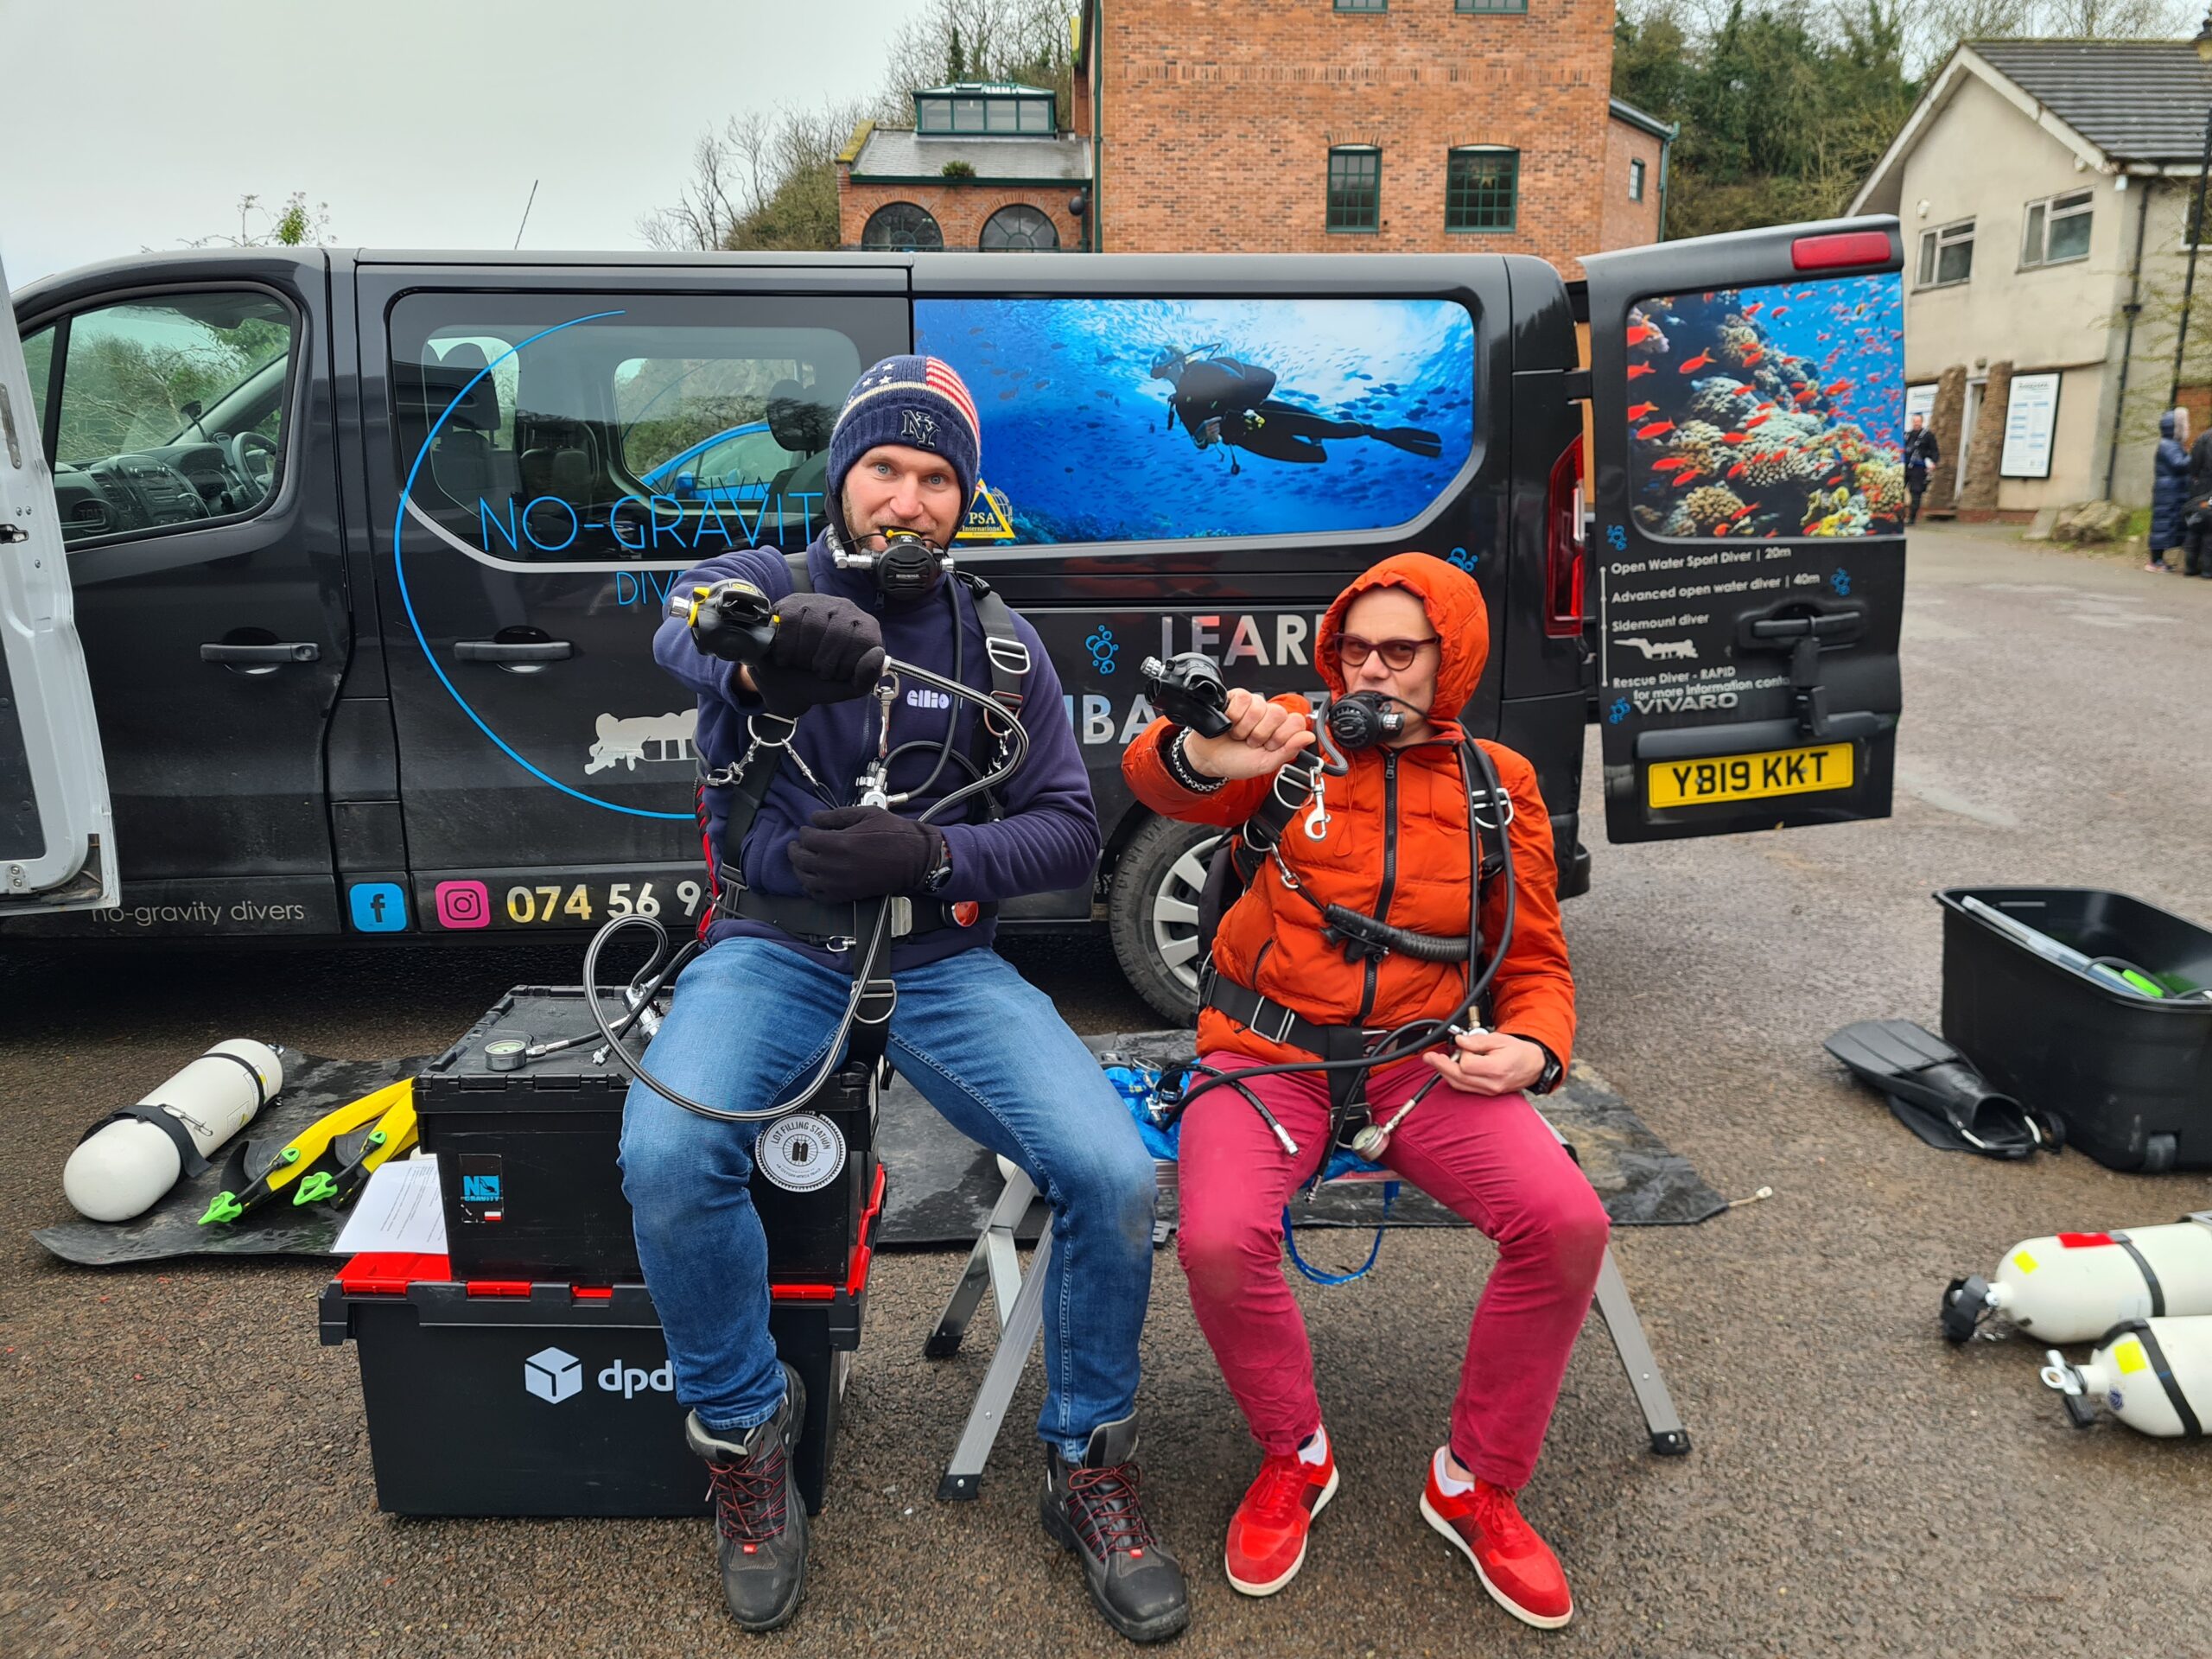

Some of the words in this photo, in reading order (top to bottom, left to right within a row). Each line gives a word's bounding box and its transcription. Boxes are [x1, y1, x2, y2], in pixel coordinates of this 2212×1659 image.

[901, 410, 941, 448] NY
[969, 512, 995, 524] PSA
[1611, 562, 1646, 575] Open
[1649, 556, 1685, 571] Water
[1686, 553, 1719, 569] Sport
[1720, 550, 1752, 563] Diver
[1764, 546, 1792, 559] 20m
[616, 571, 685, 605] DIV
[1611, 587, 1676, 603] Advanced
[1678, 585, 1712, 599] open
[1713, 580, 1748, 594] water
[1750, 576, 1782, 590] diver
[1794, 572, 1821, 586] 40m
[1611, 615, 1676, 632] Sidemount
[1679, 613, 1710, 626] diver
[1162, 614, 1326, 666] LEAR
[1612, 677, 1656, 689] Rescue
[1658, 671, 1689, 685] Diver
[1700, 665, 1736, 680] RAPID
[1633, 688, 1649, 701] for
[1652, 688, 1684, 699] more
[1686, 678, 1753, 696] information
[1633, 691, 1738, 715] VIVARO
[1673, 760, 1751, 797] YB19
[1763, 751, 1829, 788] KKT
[92, 901, 221, 926] no-gravity
[230, 900, 304, 921] divers
[506, 885, 592, 923] 074
[607, 882, 661, 919] 56
[771, 1130, 784, 1145] LOT
[780, 1121, 810, 1135] FILLING
[810, 1124, 831, 1150] STATION
[597, 1358, 674, 1399] dpd
